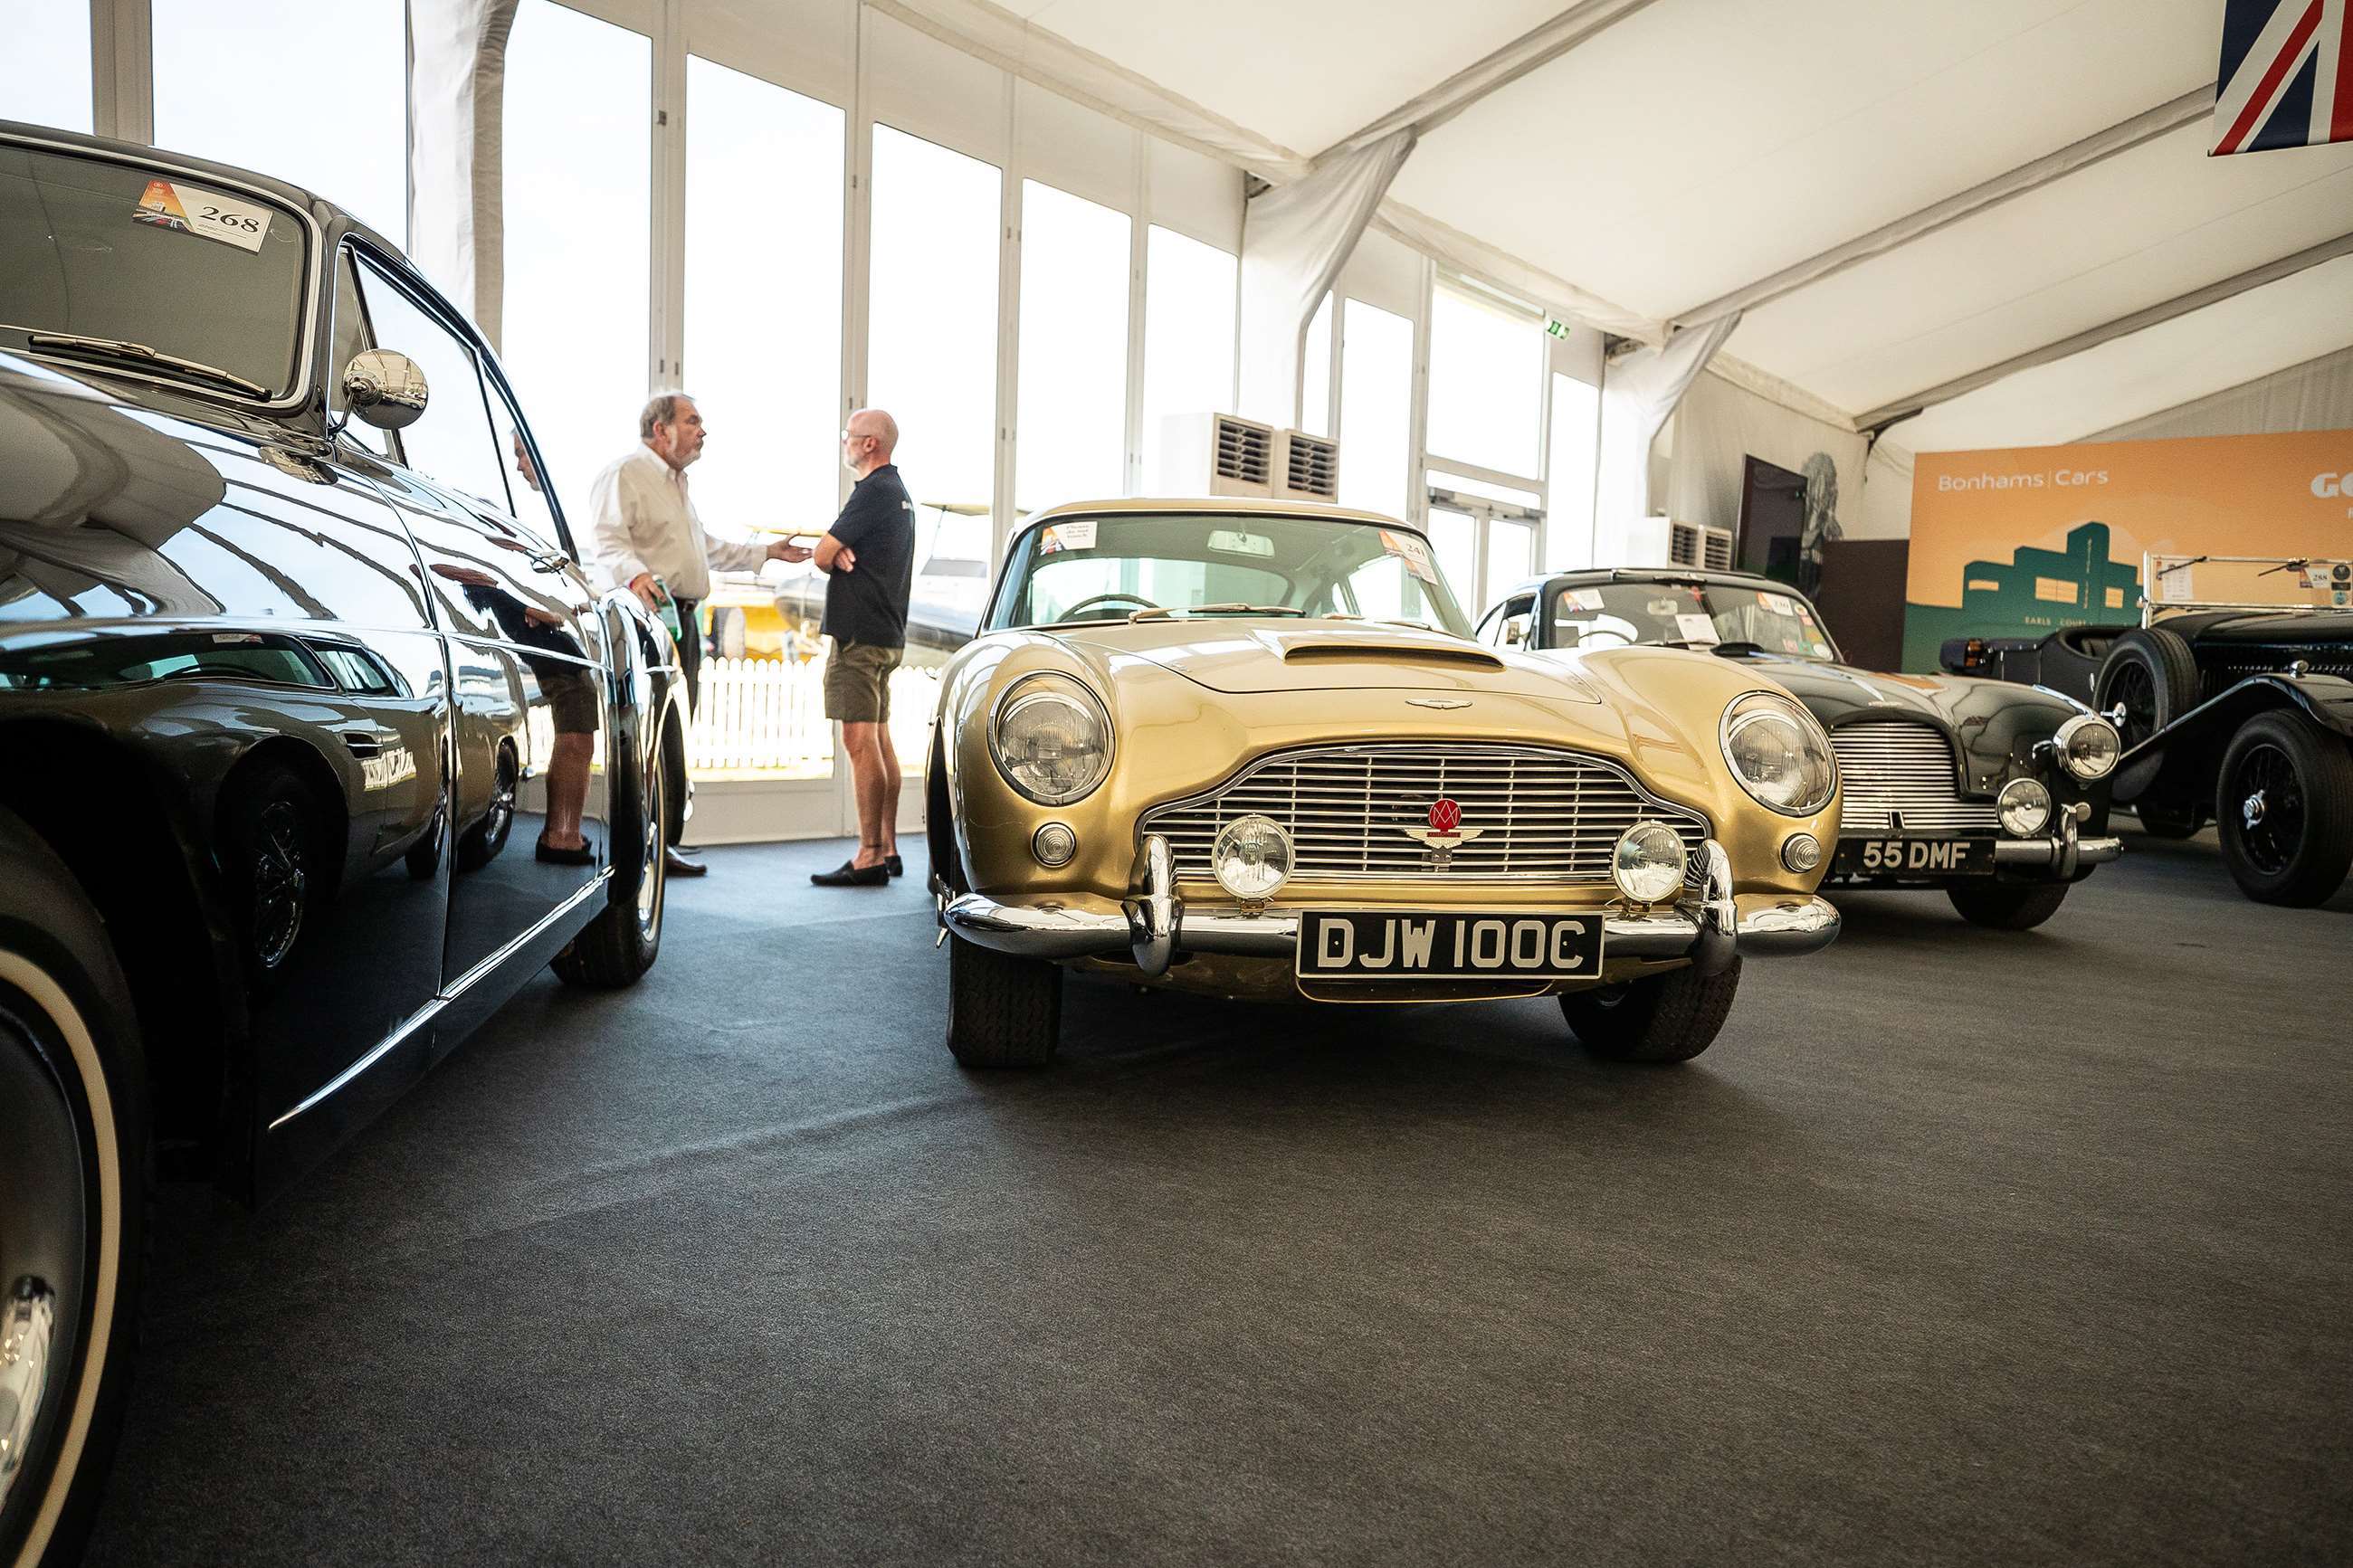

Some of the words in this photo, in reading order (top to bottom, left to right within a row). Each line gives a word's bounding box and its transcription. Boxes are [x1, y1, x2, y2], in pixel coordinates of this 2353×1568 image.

[199, 206, 261, 233] 268
[1939, 471, 2044, 492] Bonhams
[2055, 469, 2110, 486] Cars
[1862, 841, 1903, 869] 55
[1908, 841, 1971, 870] DMF
[1317, 918, 1436, 968] DJW
[1453, 919, 1586, 969] 100C
